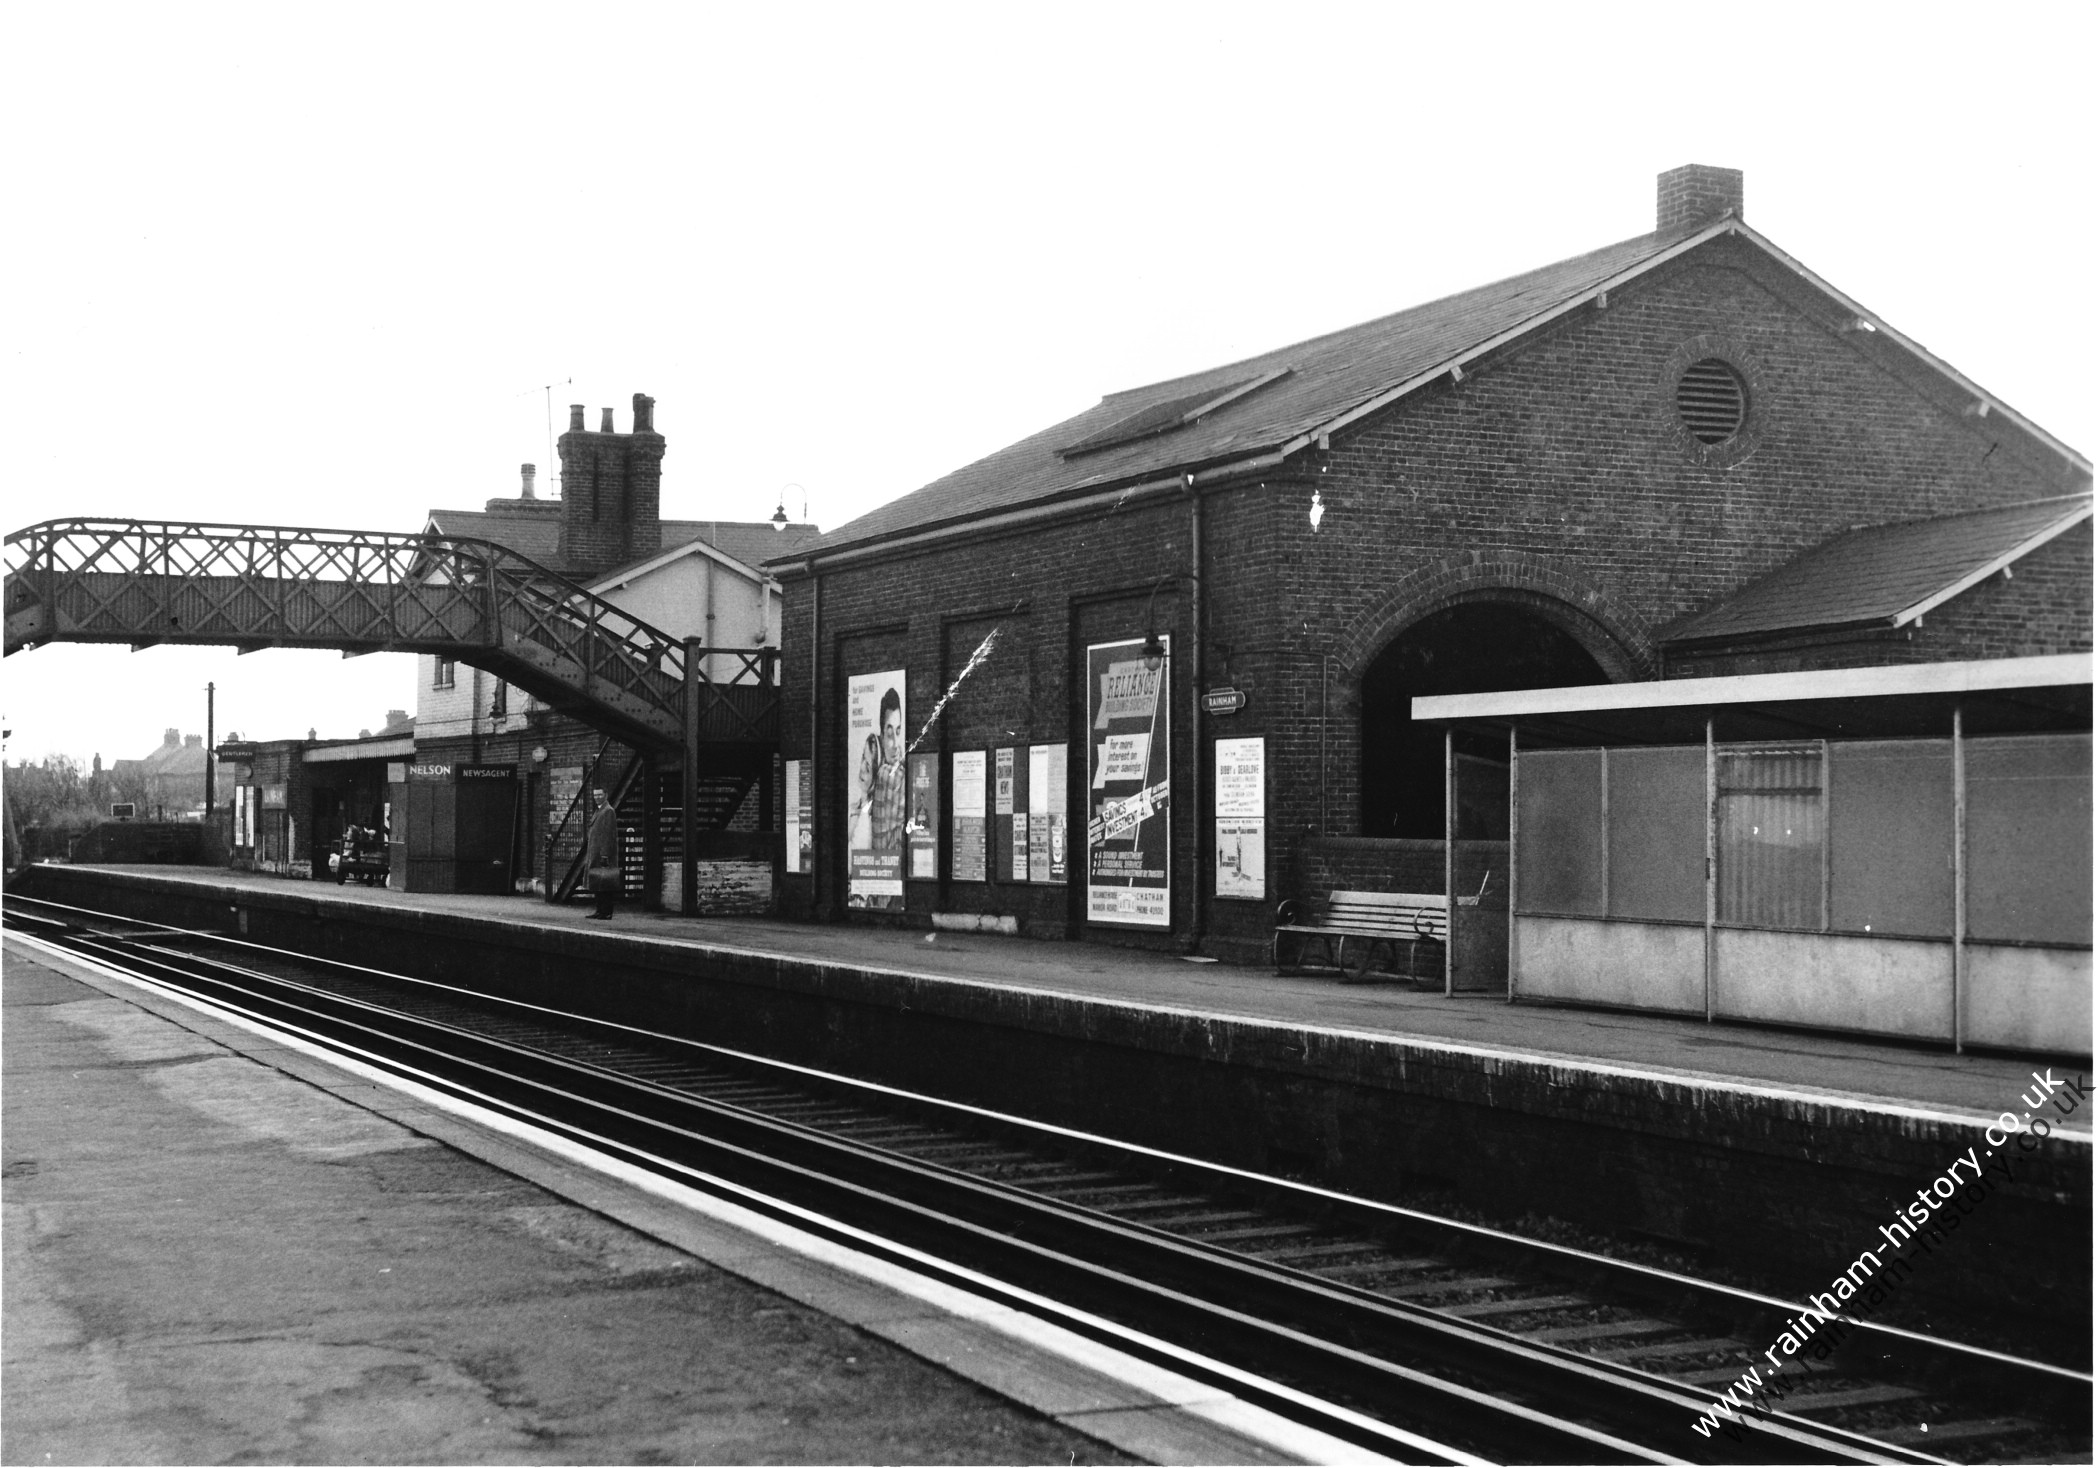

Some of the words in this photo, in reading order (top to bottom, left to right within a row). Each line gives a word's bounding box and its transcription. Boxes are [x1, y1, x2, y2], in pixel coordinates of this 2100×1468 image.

[1107, 671, 1157, 699] RELIANCE
[1105, 699, 1129, 713] BUILDING
[1130, 697, 1153, 711] SOCIETY
[1208, 695, 1237, 707] RAINHAM
[1110, 738, 1119, 749] for
[1119, 741, 1133, 749] more
[1107, 751, 1130, 762] interest
[1130, 752, 1138, 760] on
[409, 764, 451, 776] NELSON
[462, 769, 511, 777] NEWSAGENT
[1105, 764, 1120, 776] your
[1104, 801, 1126, 823] SAVINGS
[1106, 810, 1138, 836] INVESTMENT
[1136, 893, 1163, 901] CHATHAM
